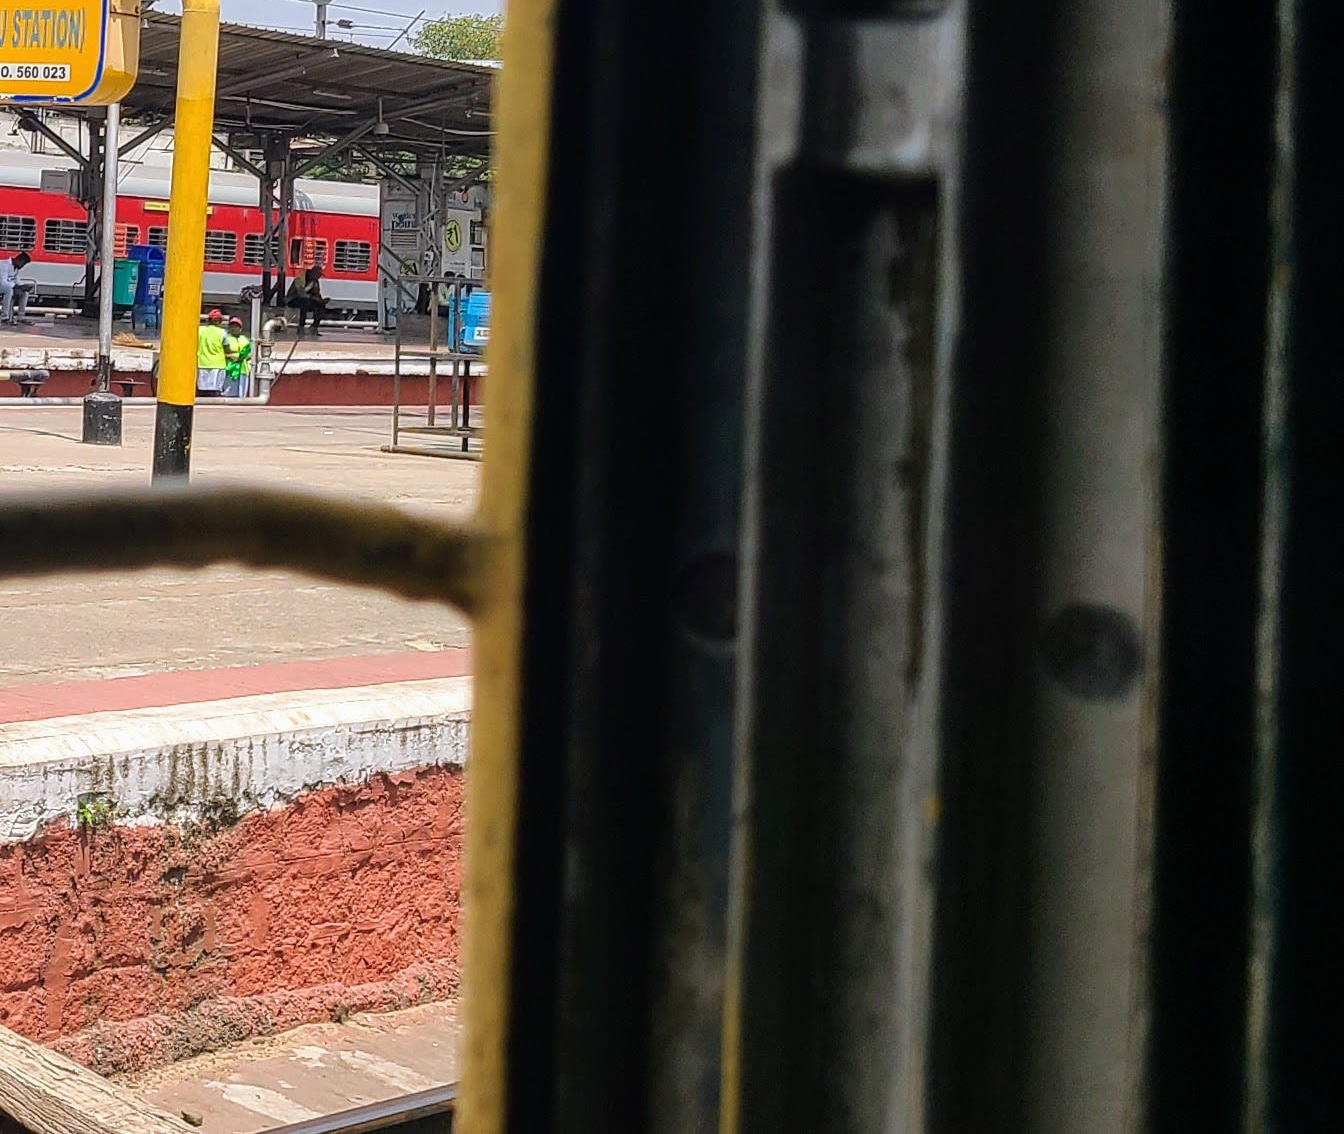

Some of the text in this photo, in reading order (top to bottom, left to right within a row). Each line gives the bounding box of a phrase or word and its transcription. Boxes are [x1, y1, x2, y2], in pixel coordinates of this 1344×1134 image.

[12, 7, 87, 53] STATION)
[16, 66, 39, 79] 560
[43, 66, 66, 79] 023
